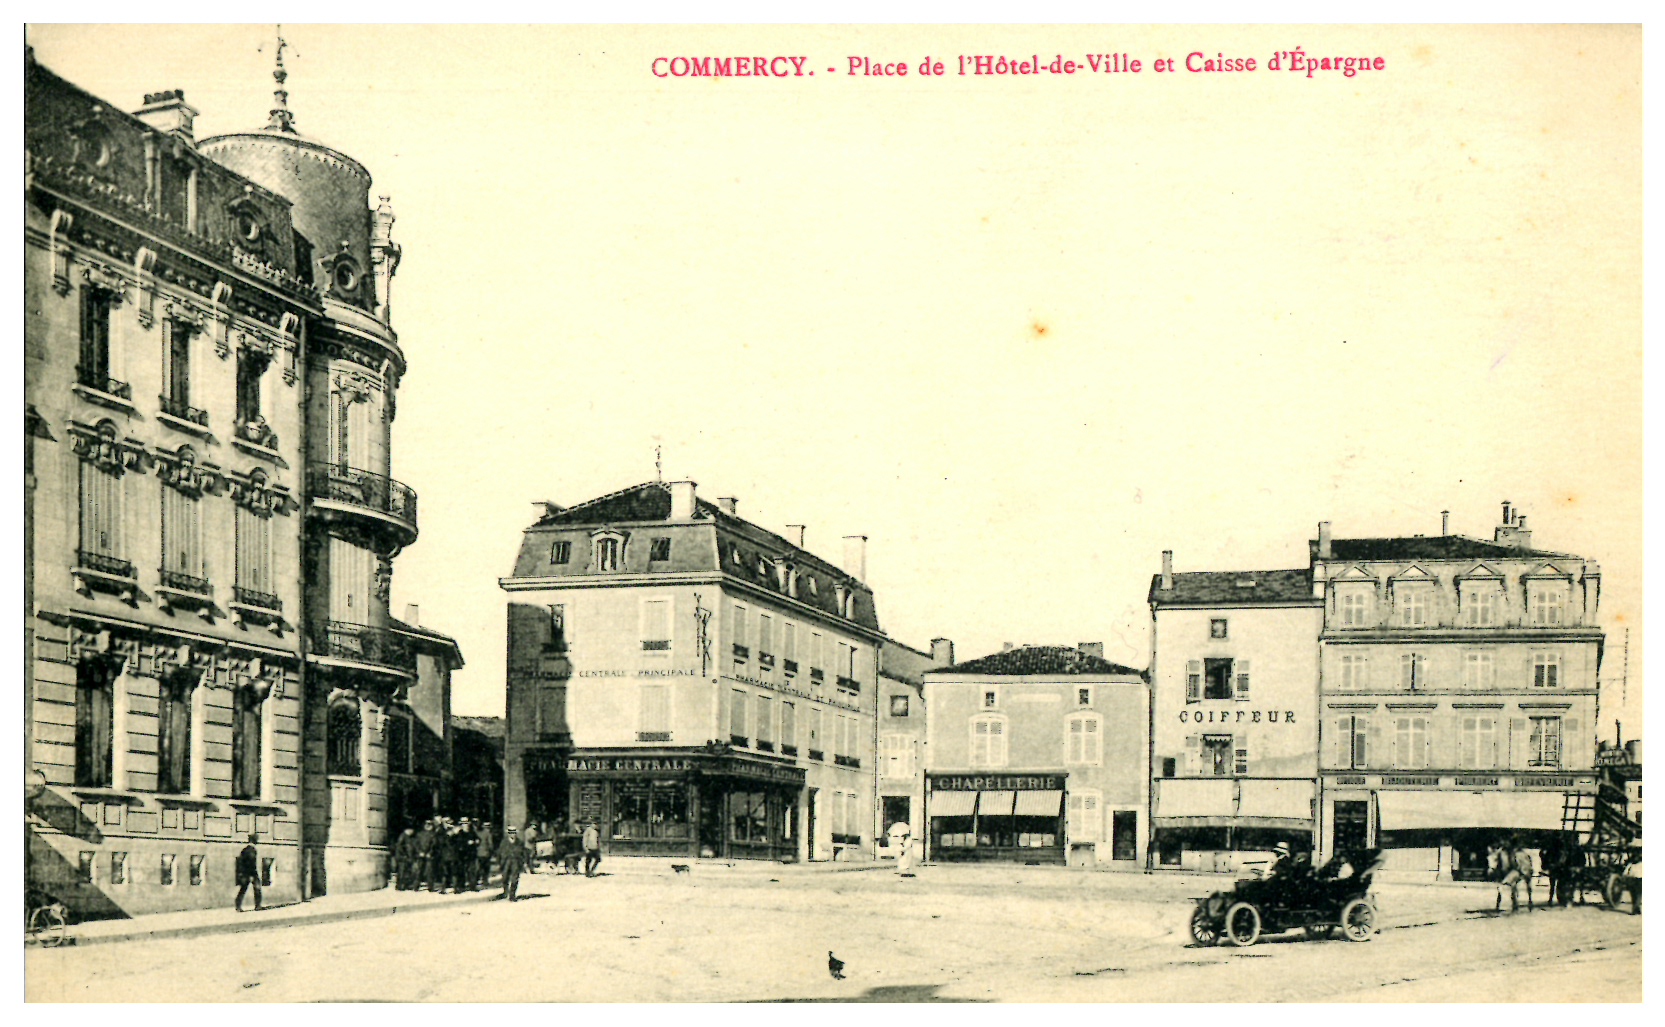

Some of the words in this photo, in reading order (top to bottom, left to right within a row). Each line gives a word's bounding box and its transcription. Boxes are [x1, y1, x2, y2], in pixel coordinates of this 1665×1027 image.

[578, 669, 627, 678] CENTRALE
[637, 668, 696, 677] PRINCIPALE
[1179, 710, 1297, 724] COIFFEUR
[615, 758, 692, 771] CENTRALE
[938, 776, 1056, 790] CHAPELLERIE
